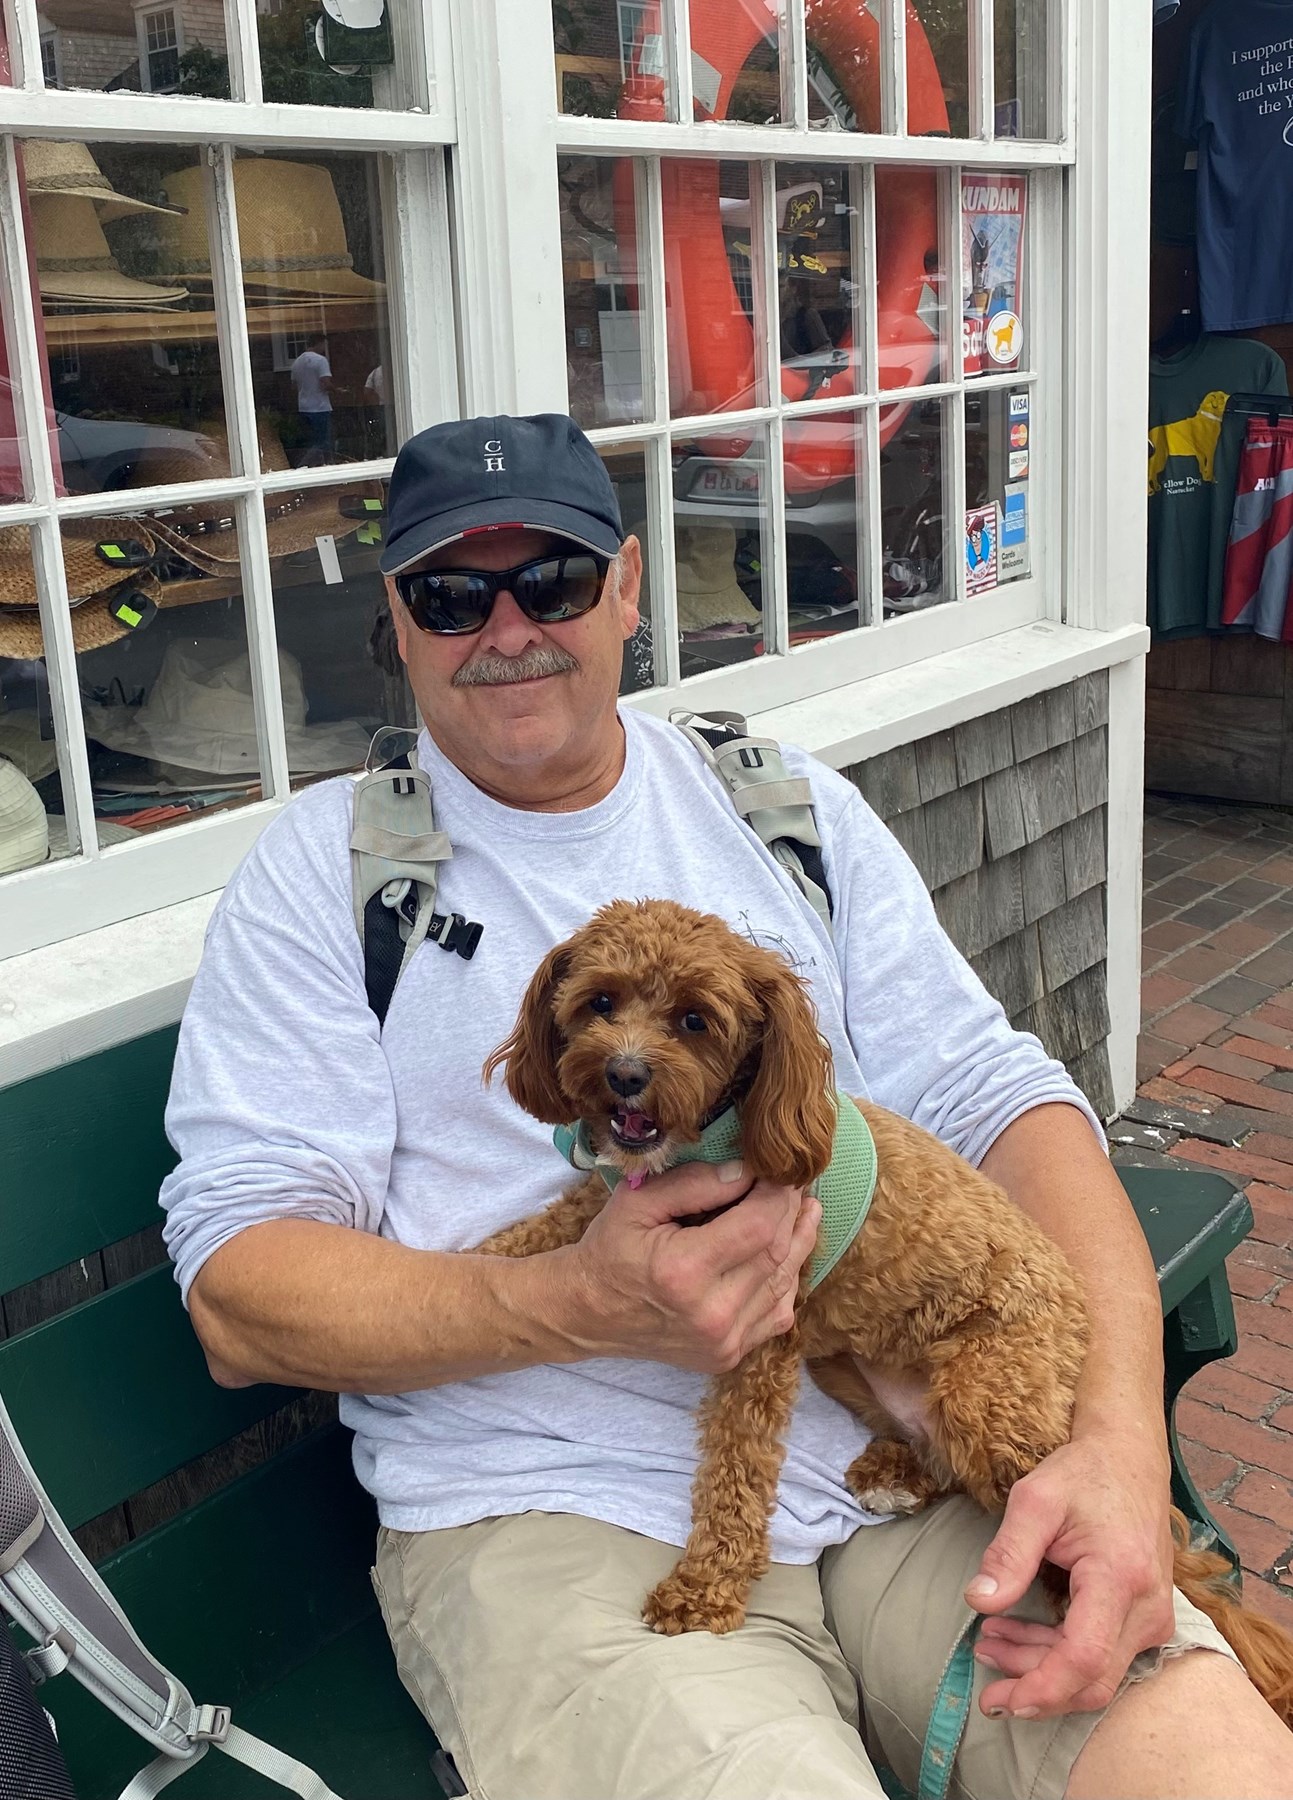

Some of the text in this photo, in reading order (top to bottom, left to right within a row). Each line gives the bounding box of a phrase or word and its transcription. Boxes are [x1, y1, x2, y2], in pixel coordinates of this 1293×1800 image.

[1232, 51, 1237, 65] I
[1240, 39, 1293, 62] support
[1260, 61, 1283, 76] the
[1238, 82, 1264, 102] and
[1258, 100, 1281, 115] the
[1012, 398, 1028, 411] VISA
[484, 440, 502, 452] C
[484, 457, 506, 472] H
[1163, 479, 1184, 488] ellow
[1002, 550, 1016, 560] Cards
[1002, 558, 1024, 570] Welcome
[738, 909, 749, 920] N
